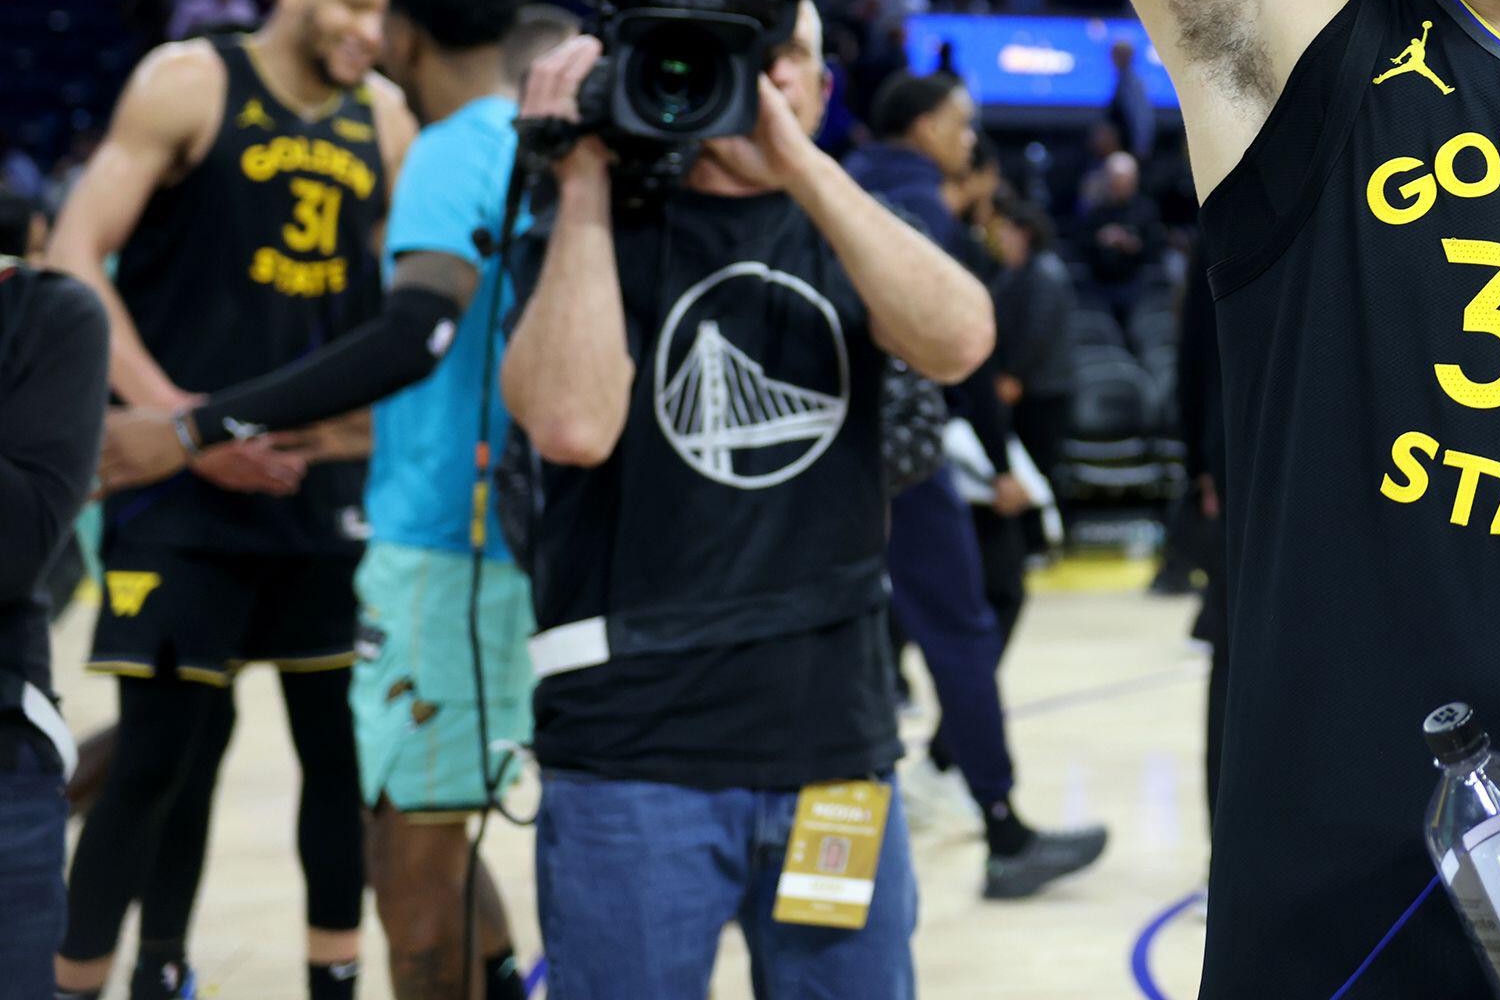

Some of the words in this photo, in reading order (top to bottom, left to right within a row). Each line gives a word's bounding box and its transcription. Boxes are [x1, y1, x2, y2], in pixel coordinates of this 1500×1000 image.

[241, 136, 376, 199] GOLDEN
[282, 176, 342, 256] 31
[249, 246, 347, 298] STATE
